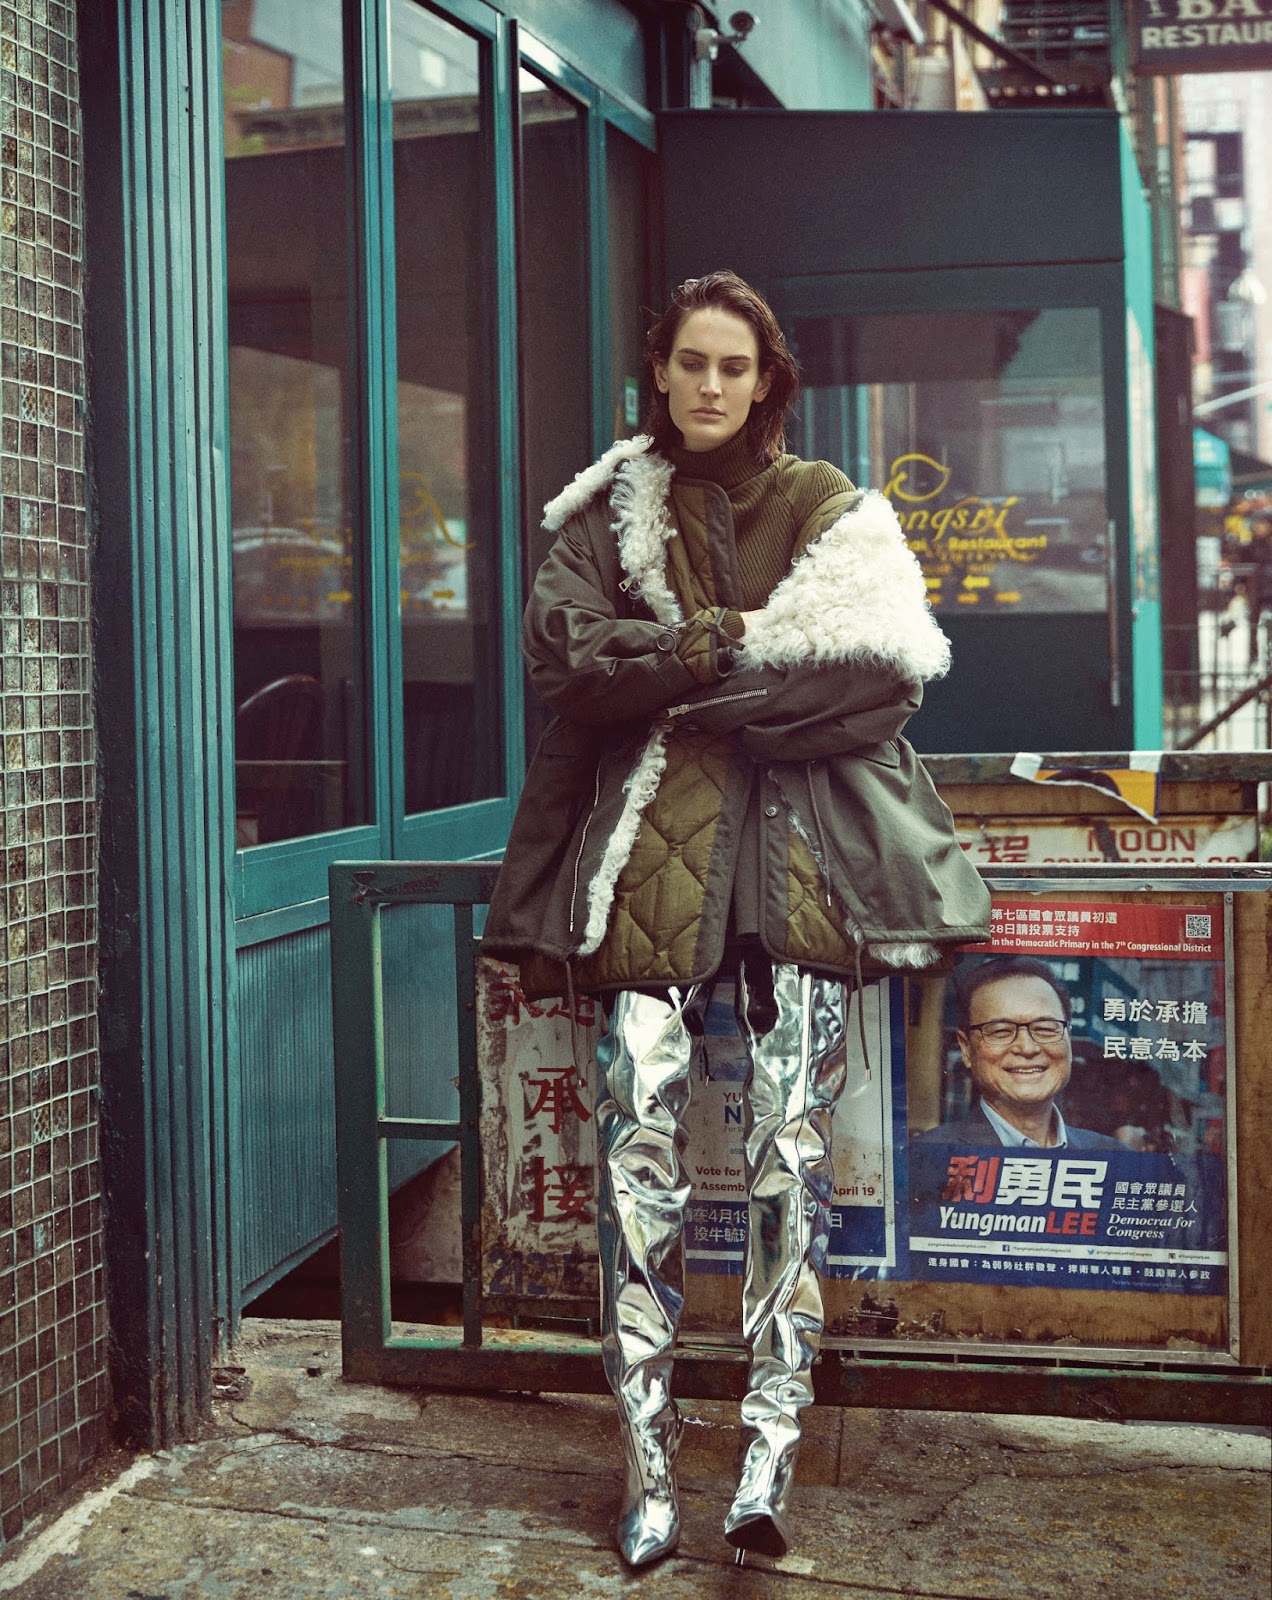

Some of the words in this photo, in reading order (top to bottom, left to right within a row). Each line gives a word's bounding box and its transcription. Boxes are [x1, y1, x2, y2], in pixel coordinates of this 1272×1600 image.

[992, 938, 1000, 946] in
[1001, 938, 1014, 947] the
[1015, 938, 1059, 948] Democratic
[1060, 940, 1091, 951] Primary
[1092, 941, 1100, 950] in
[1101, 941, 1115, 950] the
[1116, 941, 1126, 949] 7th
[1127, 942, 1182, 953] Congressional
[1182, 943, 1212, 953] District
[1103, 998, 1209, 1025] 勇於承擔
[1103, 1036, 1209, 1062] 民意為本
[695, 1166, 721, 1176] Vote
[724, 1166, 741, 1177] for
[700, 1181, 749, 1192] Assemb
[940, 1155, 1109, 1209] 利勇民
[1114, 1181, 1187, 1197] 國會眾議員
[832, 1185, 859, 1197] April
[862, 1186, 875, 1196] 19
[1111, 1197, 1198, 1213] 民主黨參選人
[1108, 1213, 1173, 1227] Democrat
[1173, 1216, 1196, 1230] for
[1106, 1225, 1165, 1240] Congress
